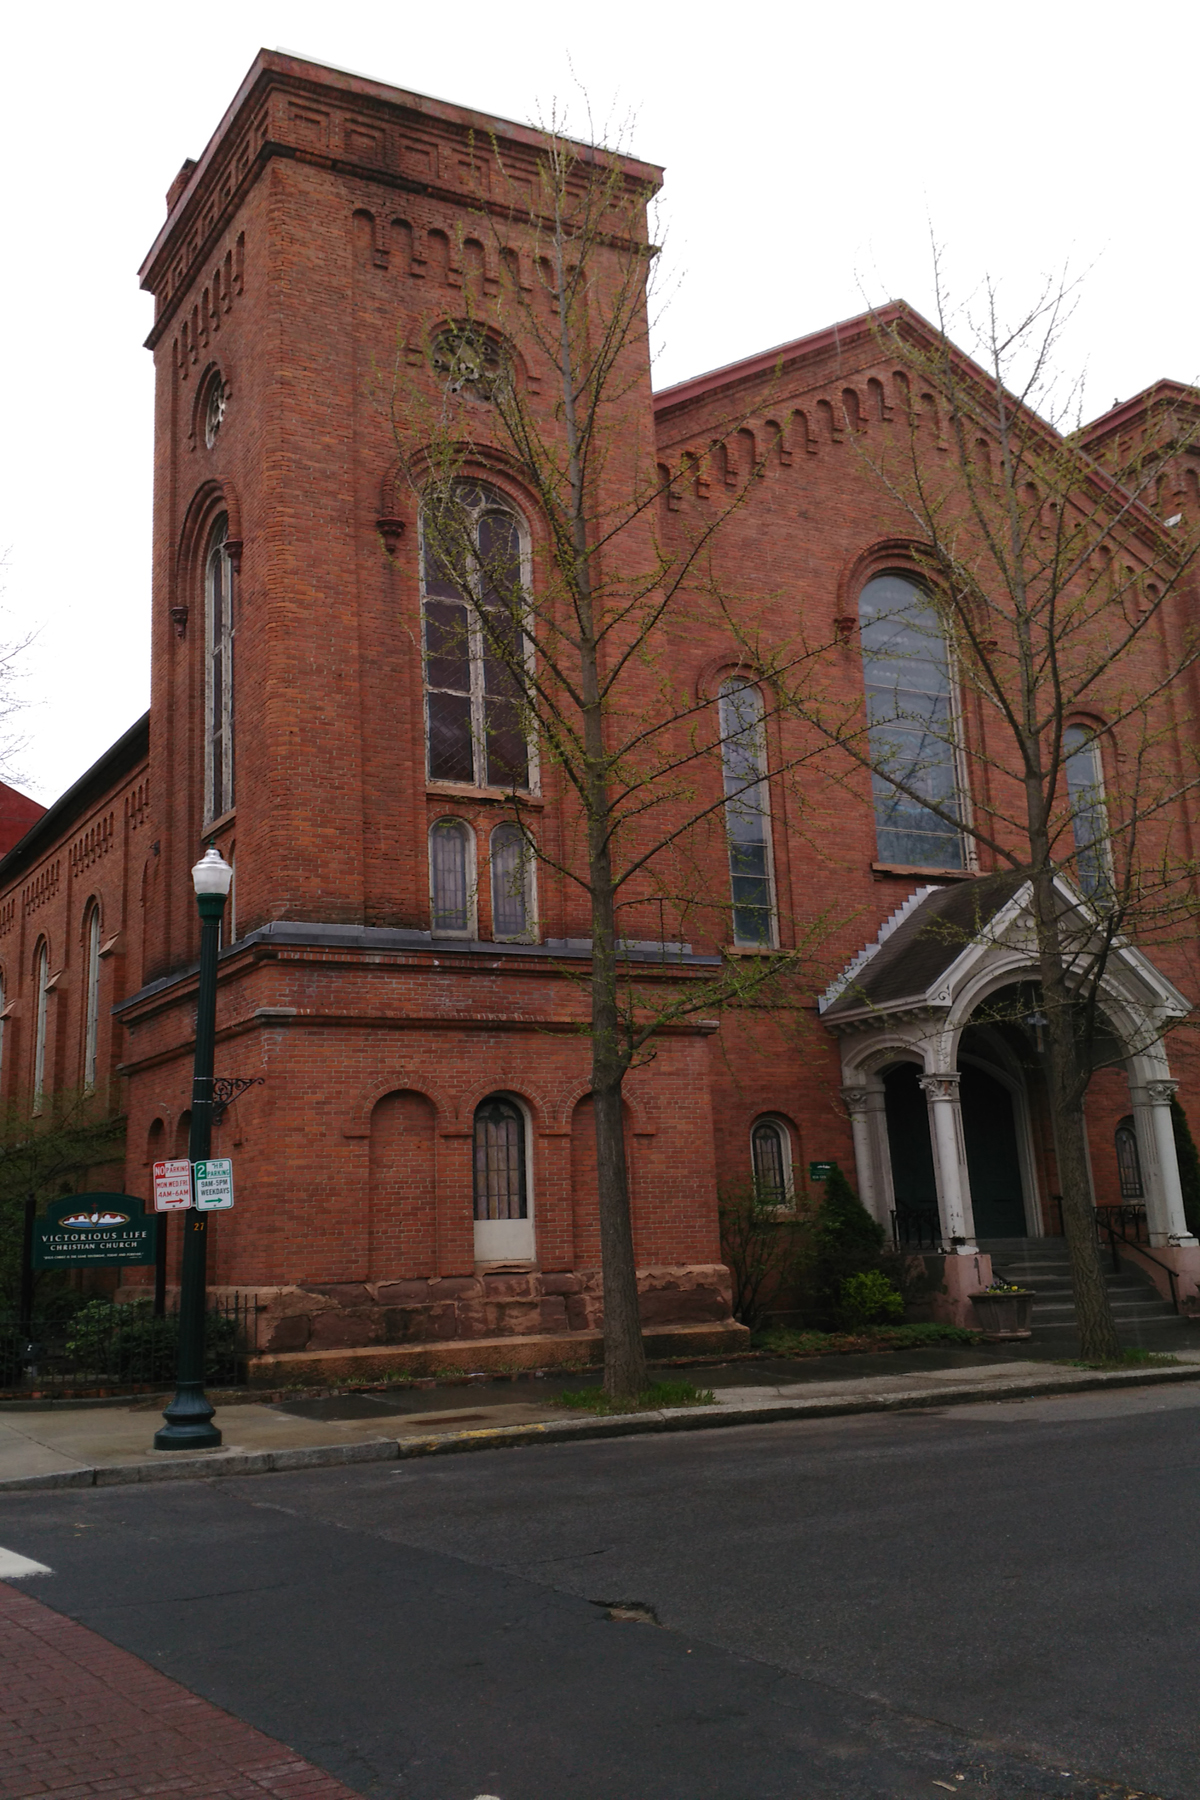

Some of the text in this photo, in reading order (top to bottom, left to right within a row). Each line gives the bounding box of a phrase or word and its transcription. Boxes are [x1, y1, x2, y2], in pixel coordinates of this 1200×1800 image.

[155, 1166, 164, 1176] NO
[197, 1165, 206, 1177] 2
[207, 1169, 229, 1177] PARKING
[200, 1179, 228, 1188] 9AM-5PM
[158, 1189, 189, 1198] 4AM-6AM
[200, 1187, 230, 1196] WEEKDAYS
[41, 1230, 147, 1241] VICTORIOUS LIFE
[50, 1241, 137, 1251] CHRISTIAN CHURCH
